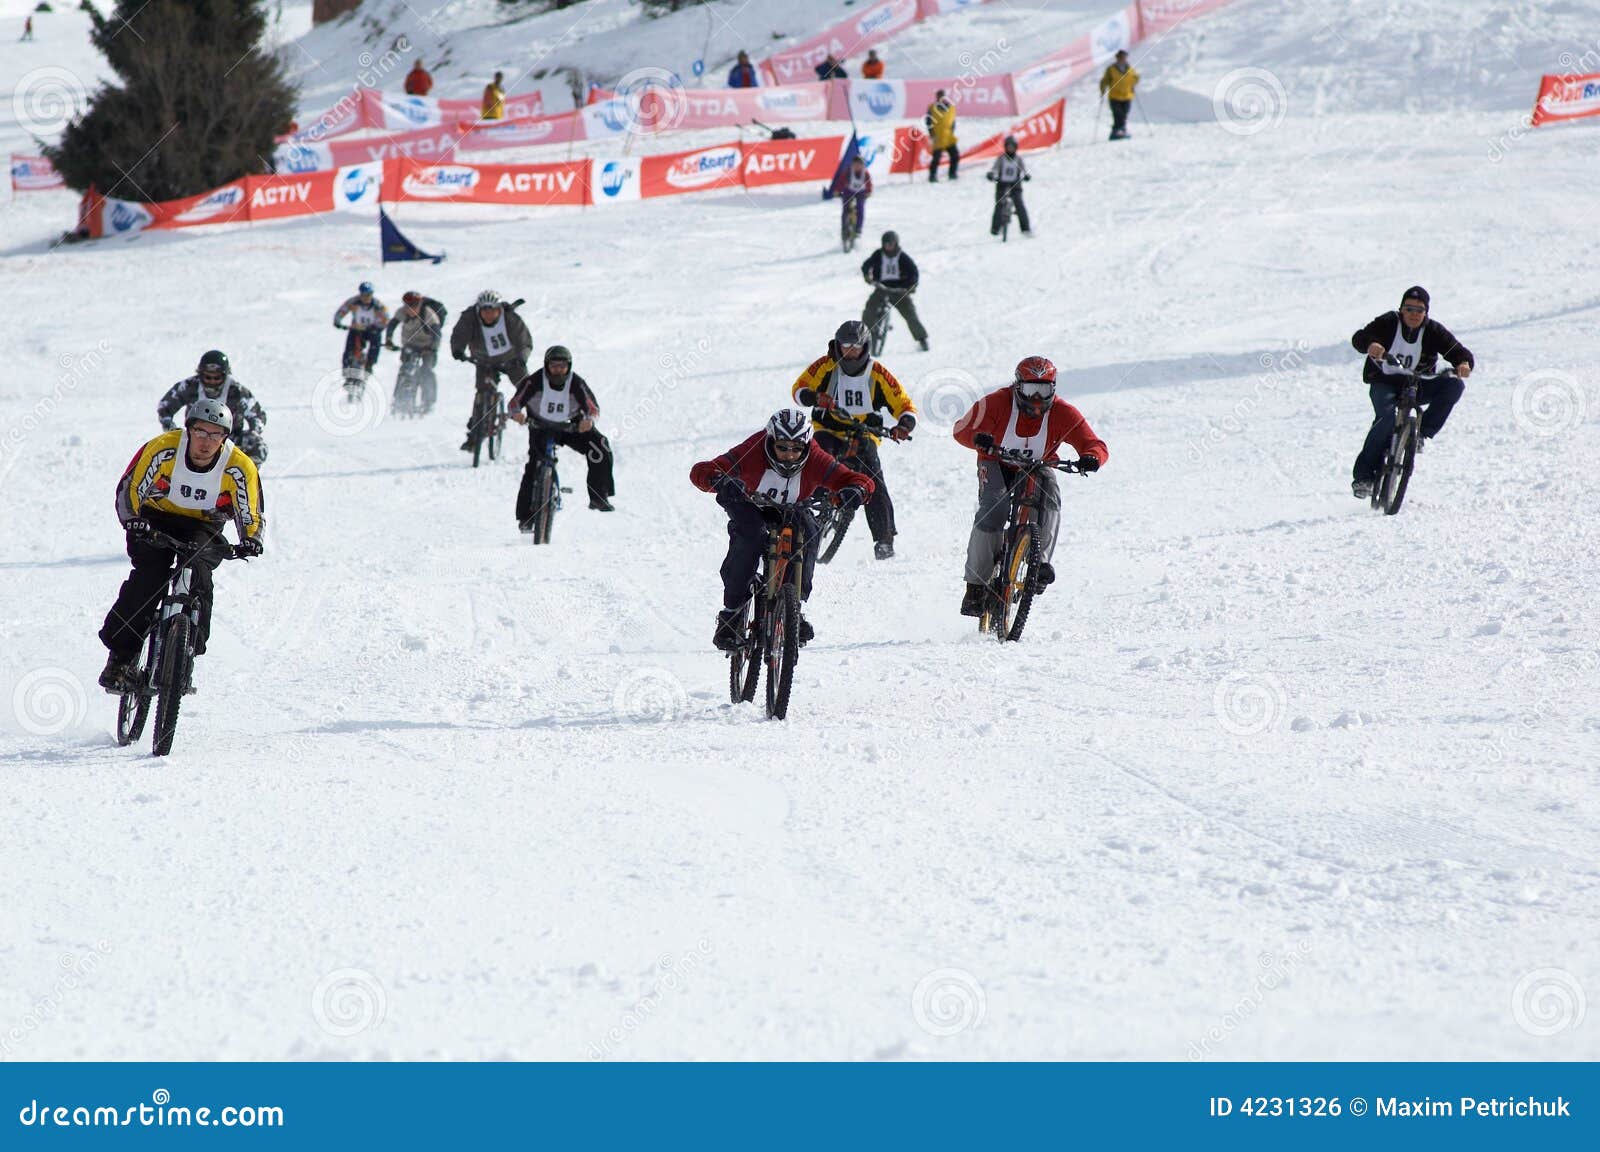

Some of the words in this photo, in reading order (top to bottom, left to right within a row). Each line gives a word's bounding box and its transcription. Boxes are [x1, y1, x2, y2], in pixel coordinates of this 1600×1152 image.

[745, 149, 816, 175] ACTIV
[496, 171, 576, 193] ACTIV
[251, 182, 312, 208] ACTIV
[845, 389, 863, 407] 68
